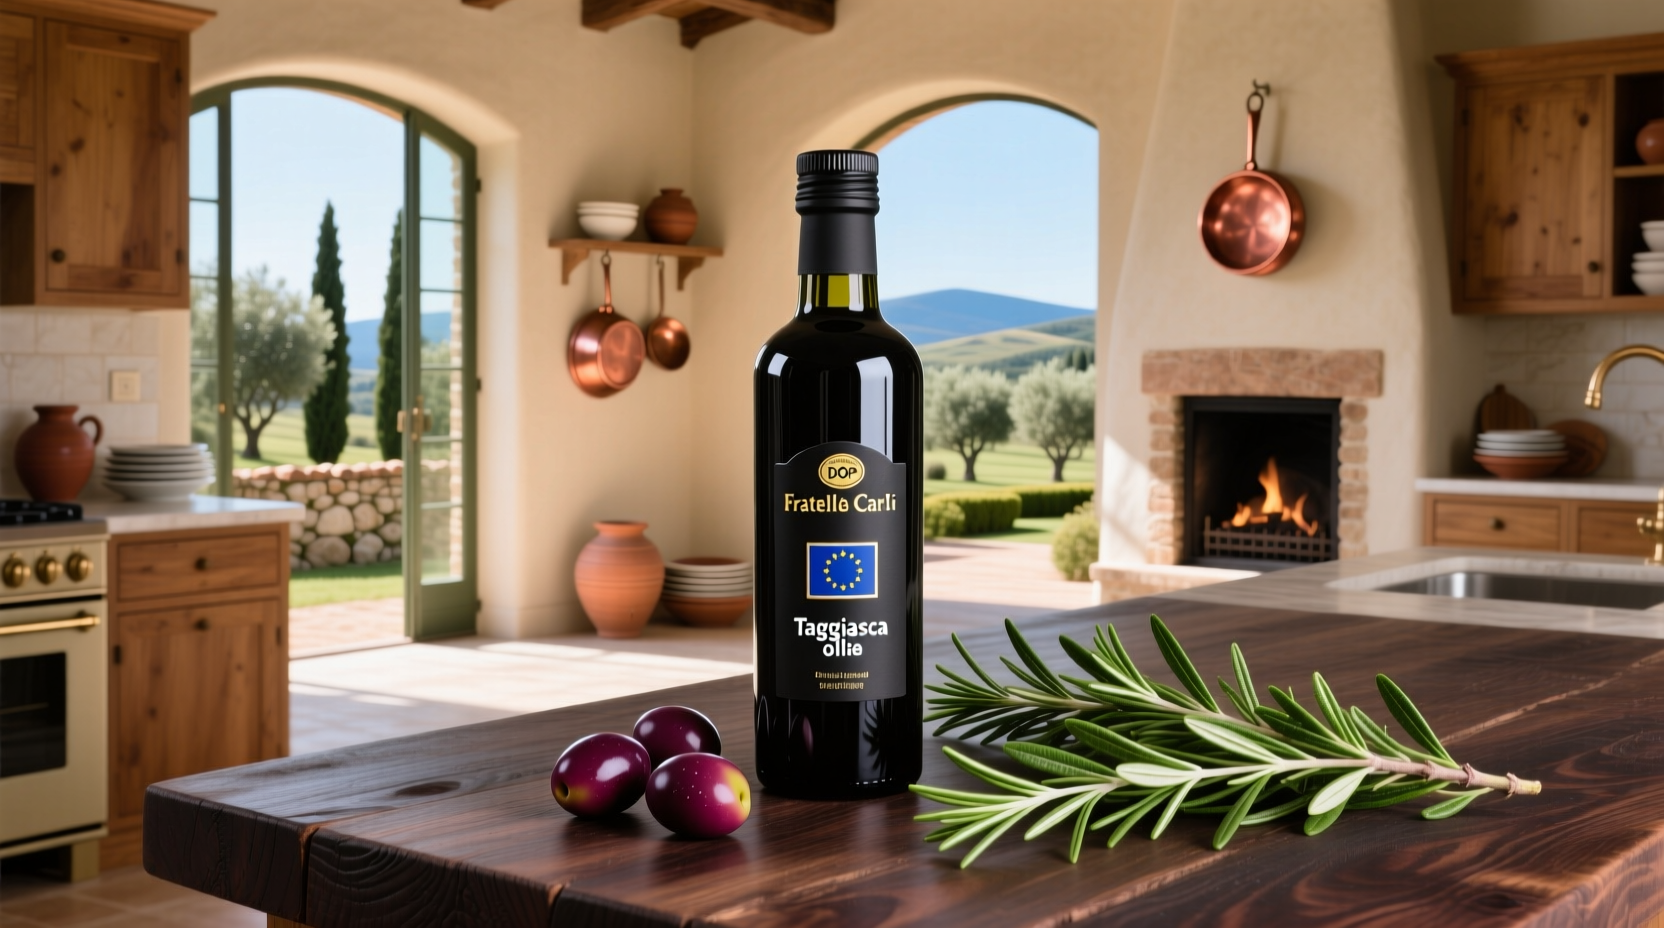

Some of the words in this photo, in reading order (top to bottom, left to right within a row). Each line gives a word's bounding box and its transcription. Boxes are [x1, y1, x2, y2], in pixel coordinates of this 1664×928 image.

[827, 466, 858, 480] DOP
[853, 493, 896, 512] Carli
[793, 616, 888, 642] Taggiasca
[822, 638, 863, 657] ollie
